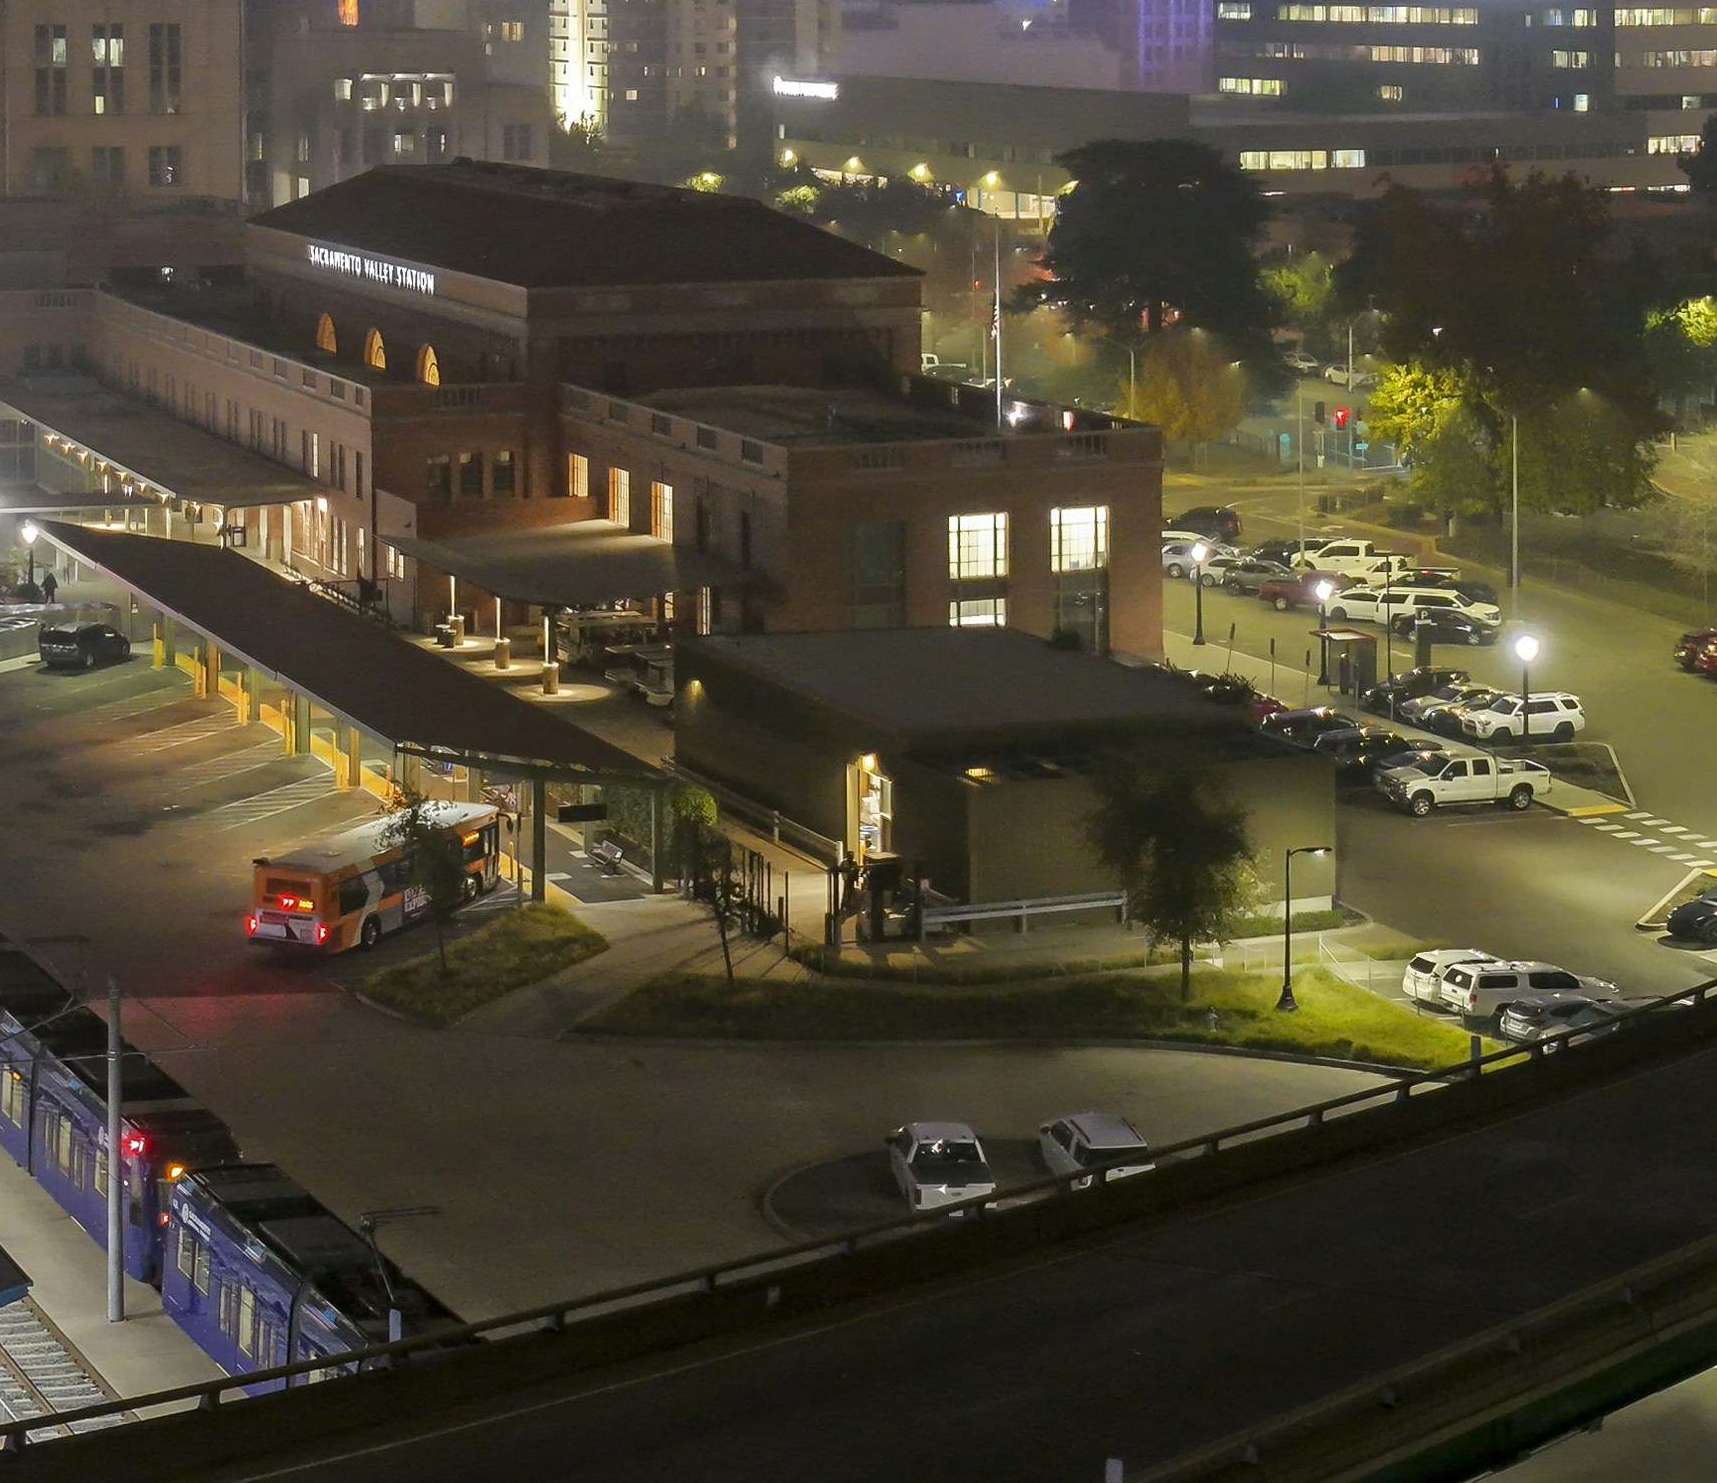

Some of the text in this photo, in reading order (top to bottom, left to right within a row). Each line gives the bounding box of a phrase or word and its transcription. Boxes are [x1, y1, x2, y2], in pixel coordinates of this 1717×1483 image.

[308, 244, 435, 297] SACRAMENTO VALLEY STATION
[1420, 610, 1429, 620] P
